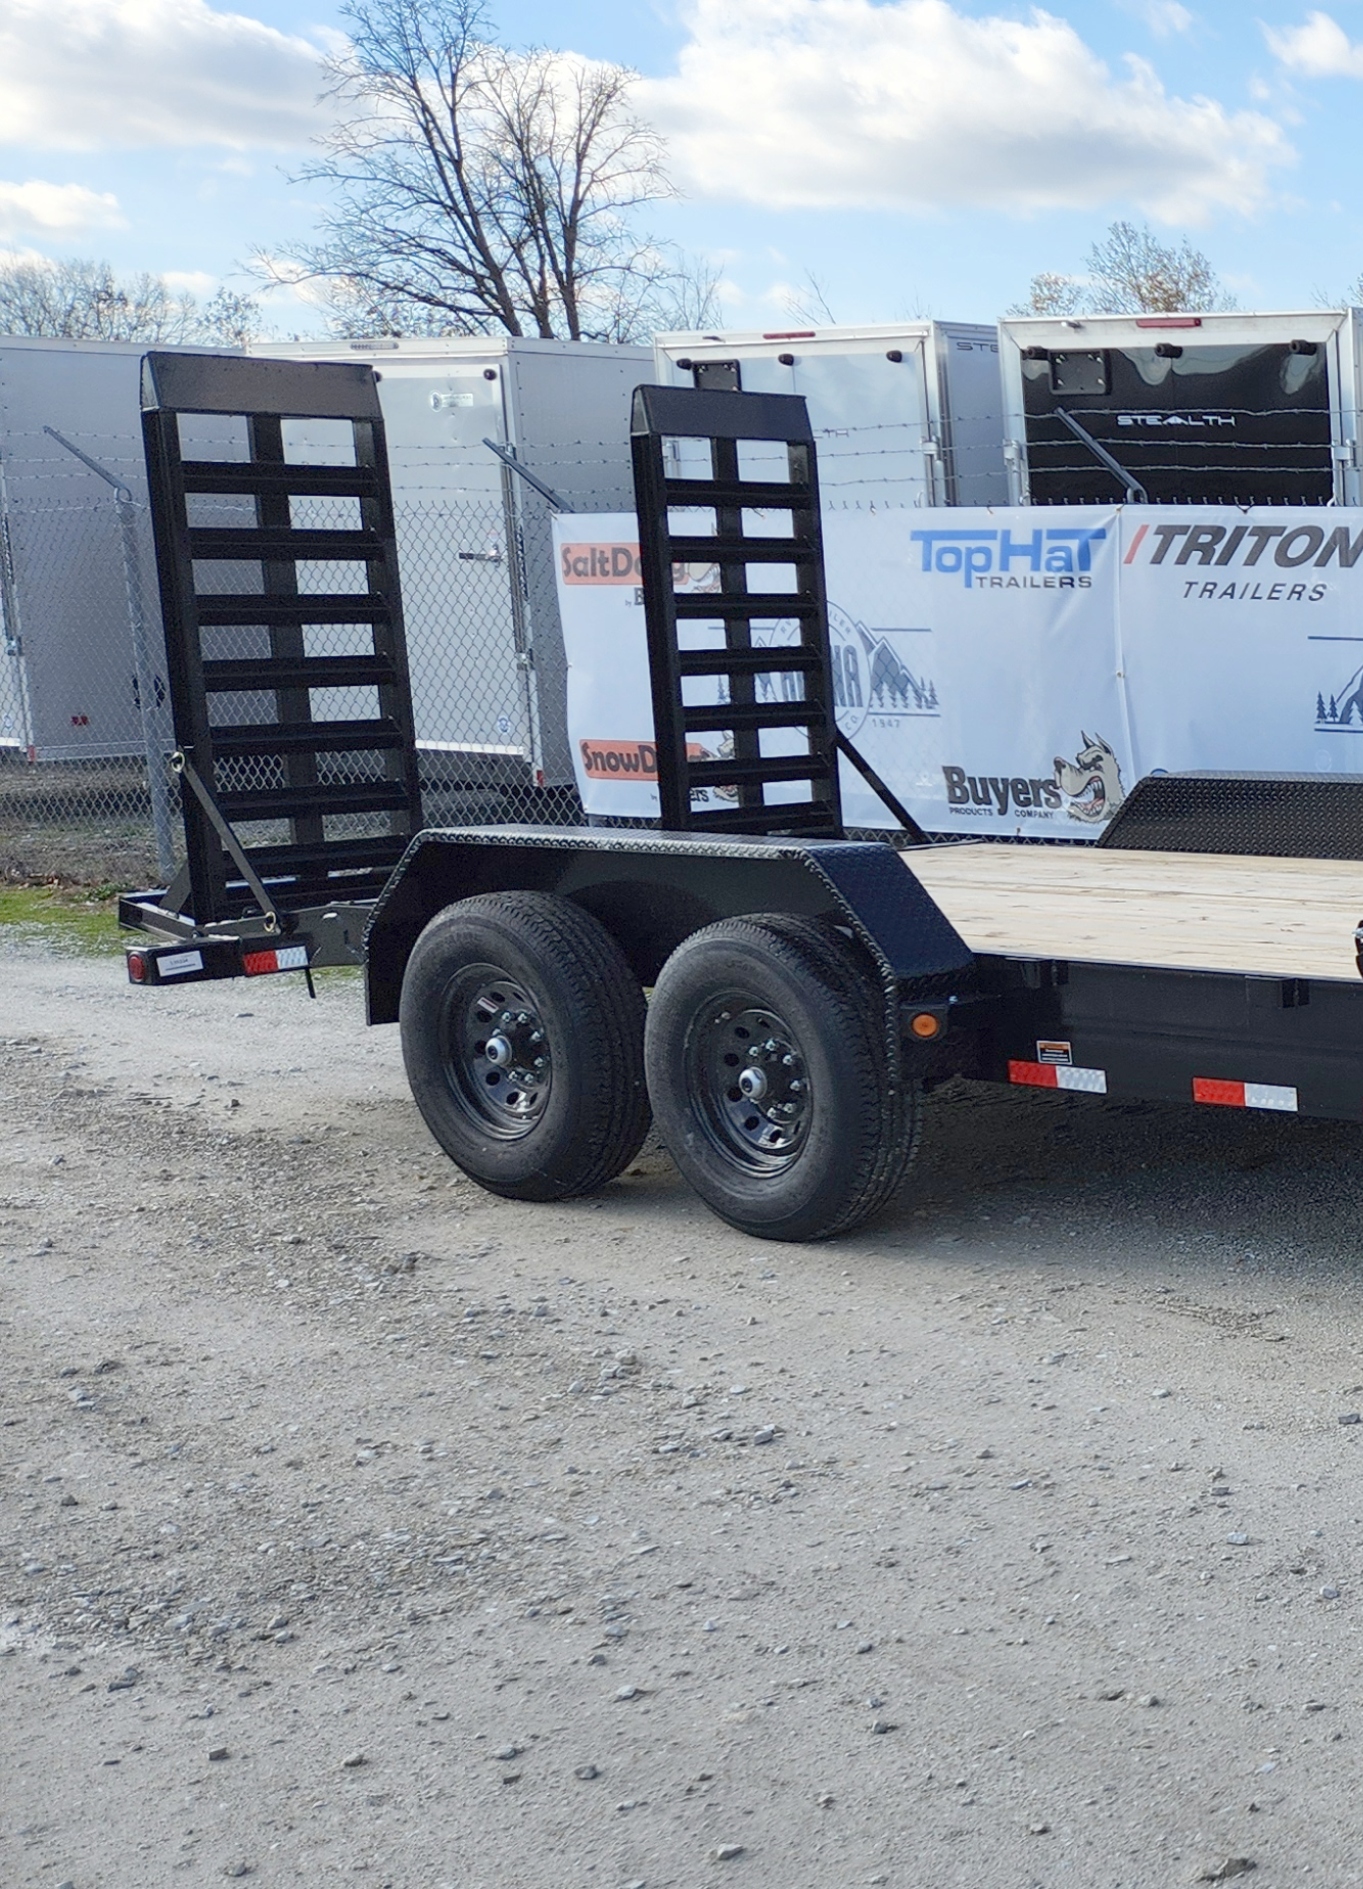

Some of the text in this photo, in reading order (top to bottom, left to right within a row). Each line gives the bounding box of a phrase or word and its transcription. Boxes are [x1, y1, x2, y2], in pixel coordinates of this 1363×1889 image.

[562, 547, 685, 582] SaltDg
[976, 576, 1092, 588] TRAILERS
[1182, 581, 1327, 601] TRAILERS
[872, 718, 901, 729] 1947
[942, 765, 1062, 815] Buyers
[950, 807, 1054, 819] PRODUCTS COMPANY
